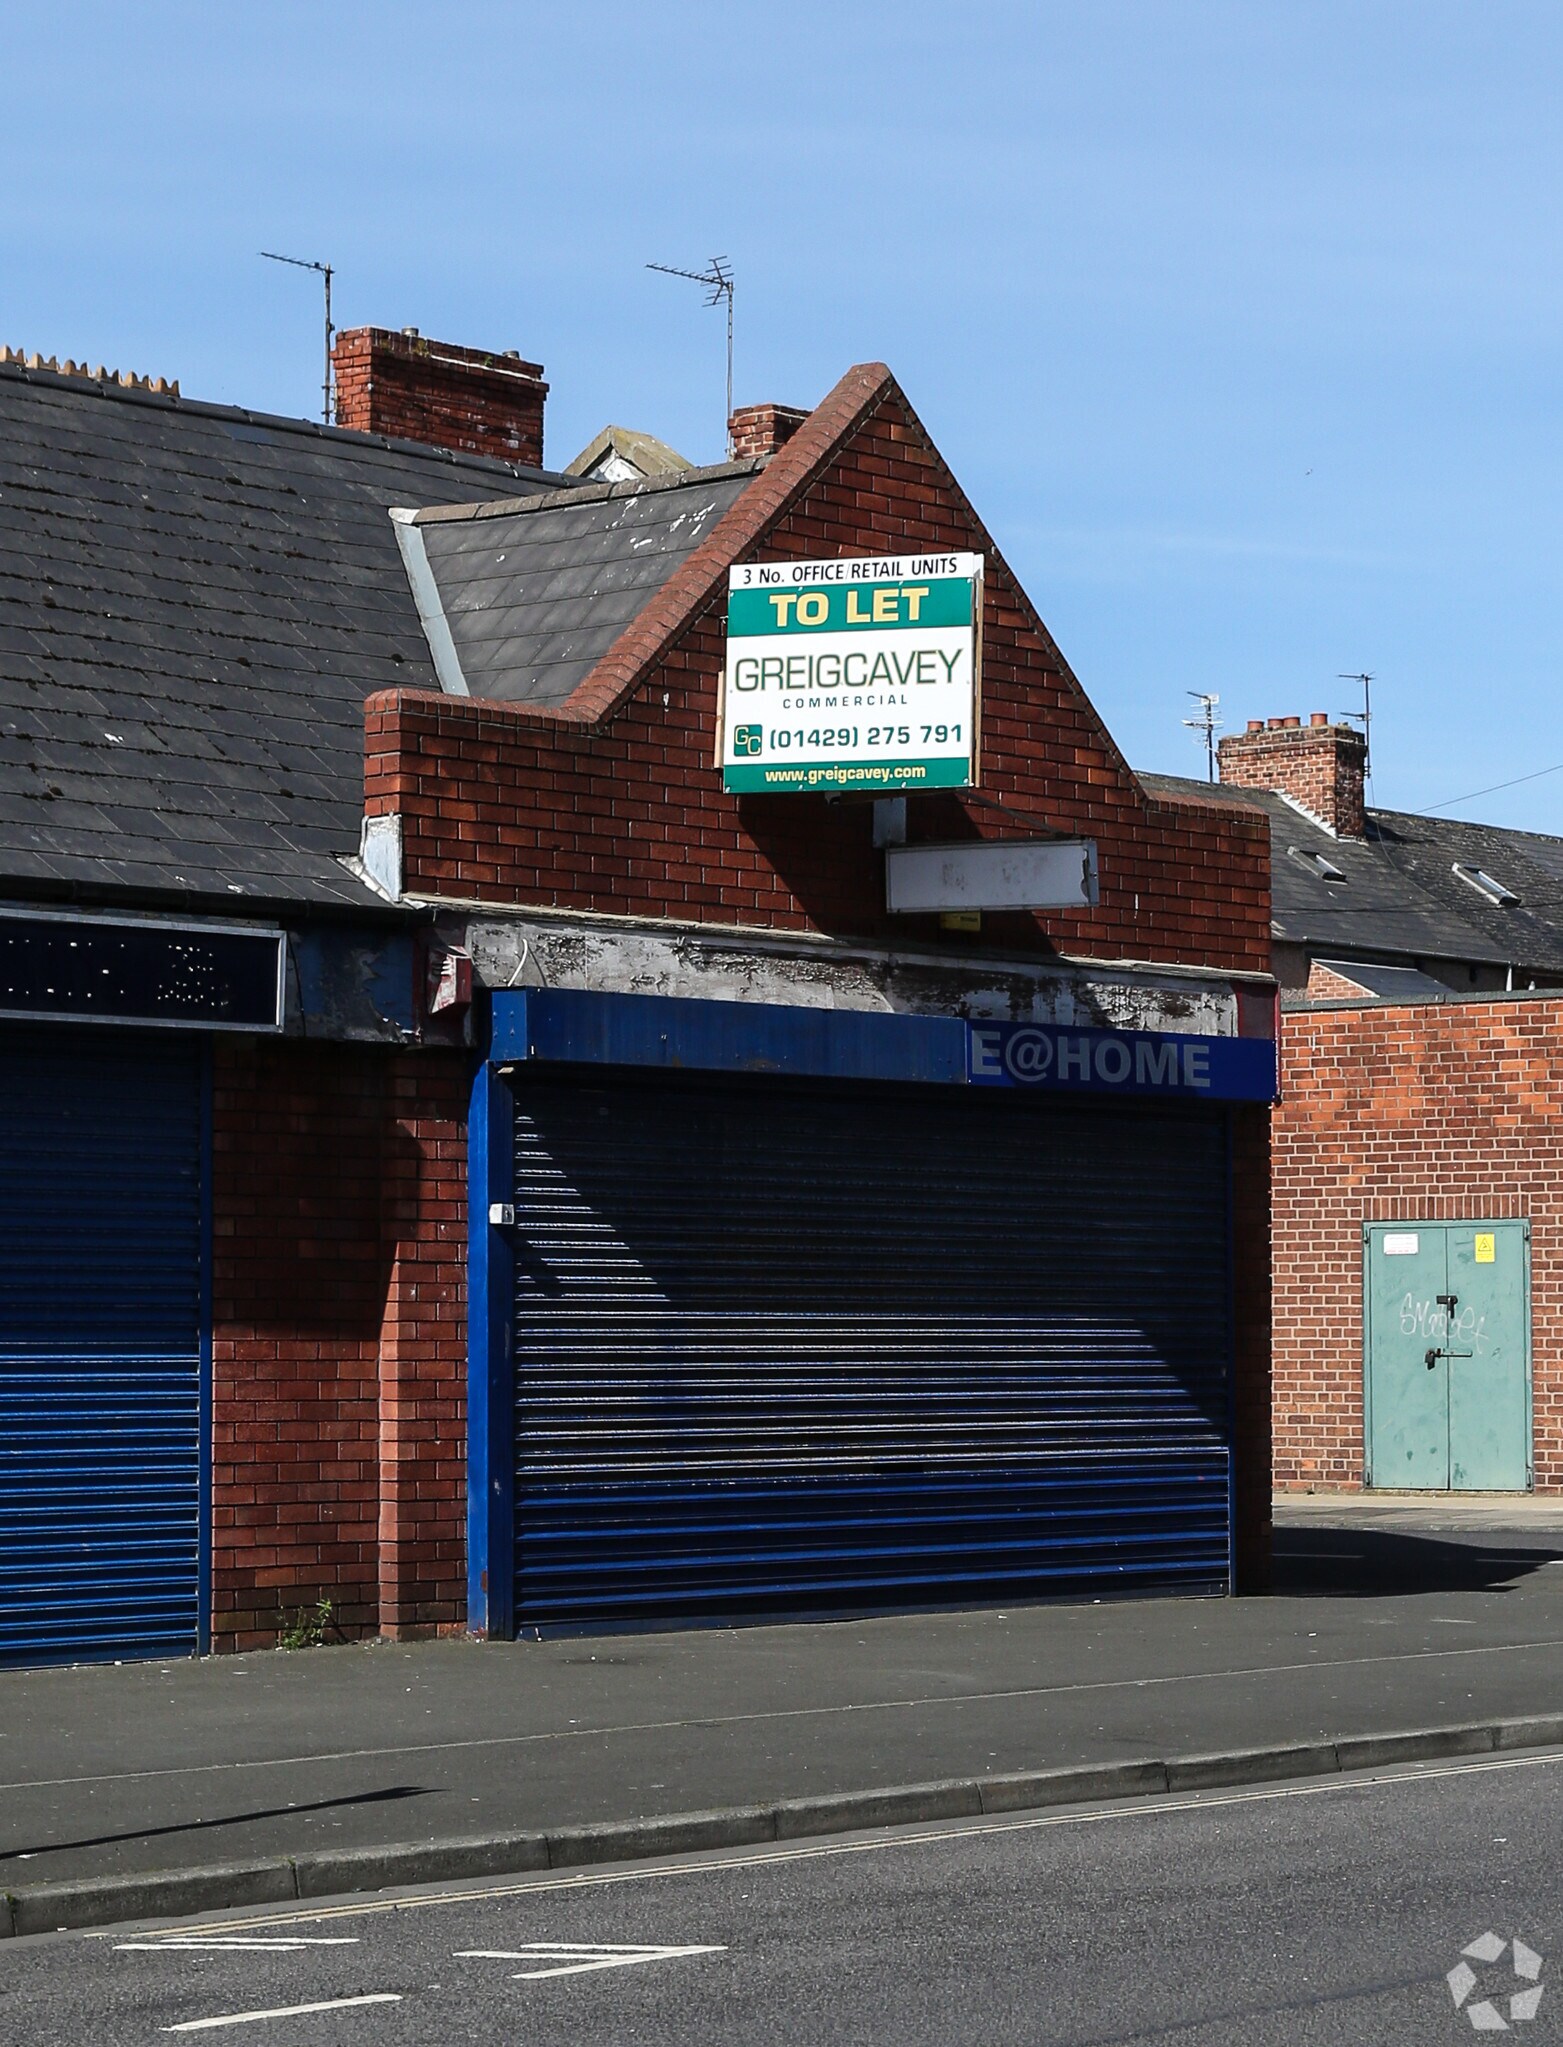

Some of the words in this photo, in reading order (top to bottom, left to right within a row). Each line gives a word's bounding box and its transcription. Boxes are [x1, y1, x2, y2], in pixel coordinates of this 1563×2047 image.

[743, 569, 752, 584] 3
[759, 568, 785, 584] No.
[911, 557, 958, 575] UNITS
[769, 592, 829, 627] TO
[846, 587, 929, 624] LET
[735, 648, 964, 692] GREIGCAVEY
[783, 694, 908, 709] COMMERCIAL
[770, 728, 858, 750] (01429)
[867, 726, 910, 745] 275
[920, 724, 962, 743] 791
[765, 765, 926, 784] www.greigcavey.com
[971, 1029, 1211, 1088] E@HOME
